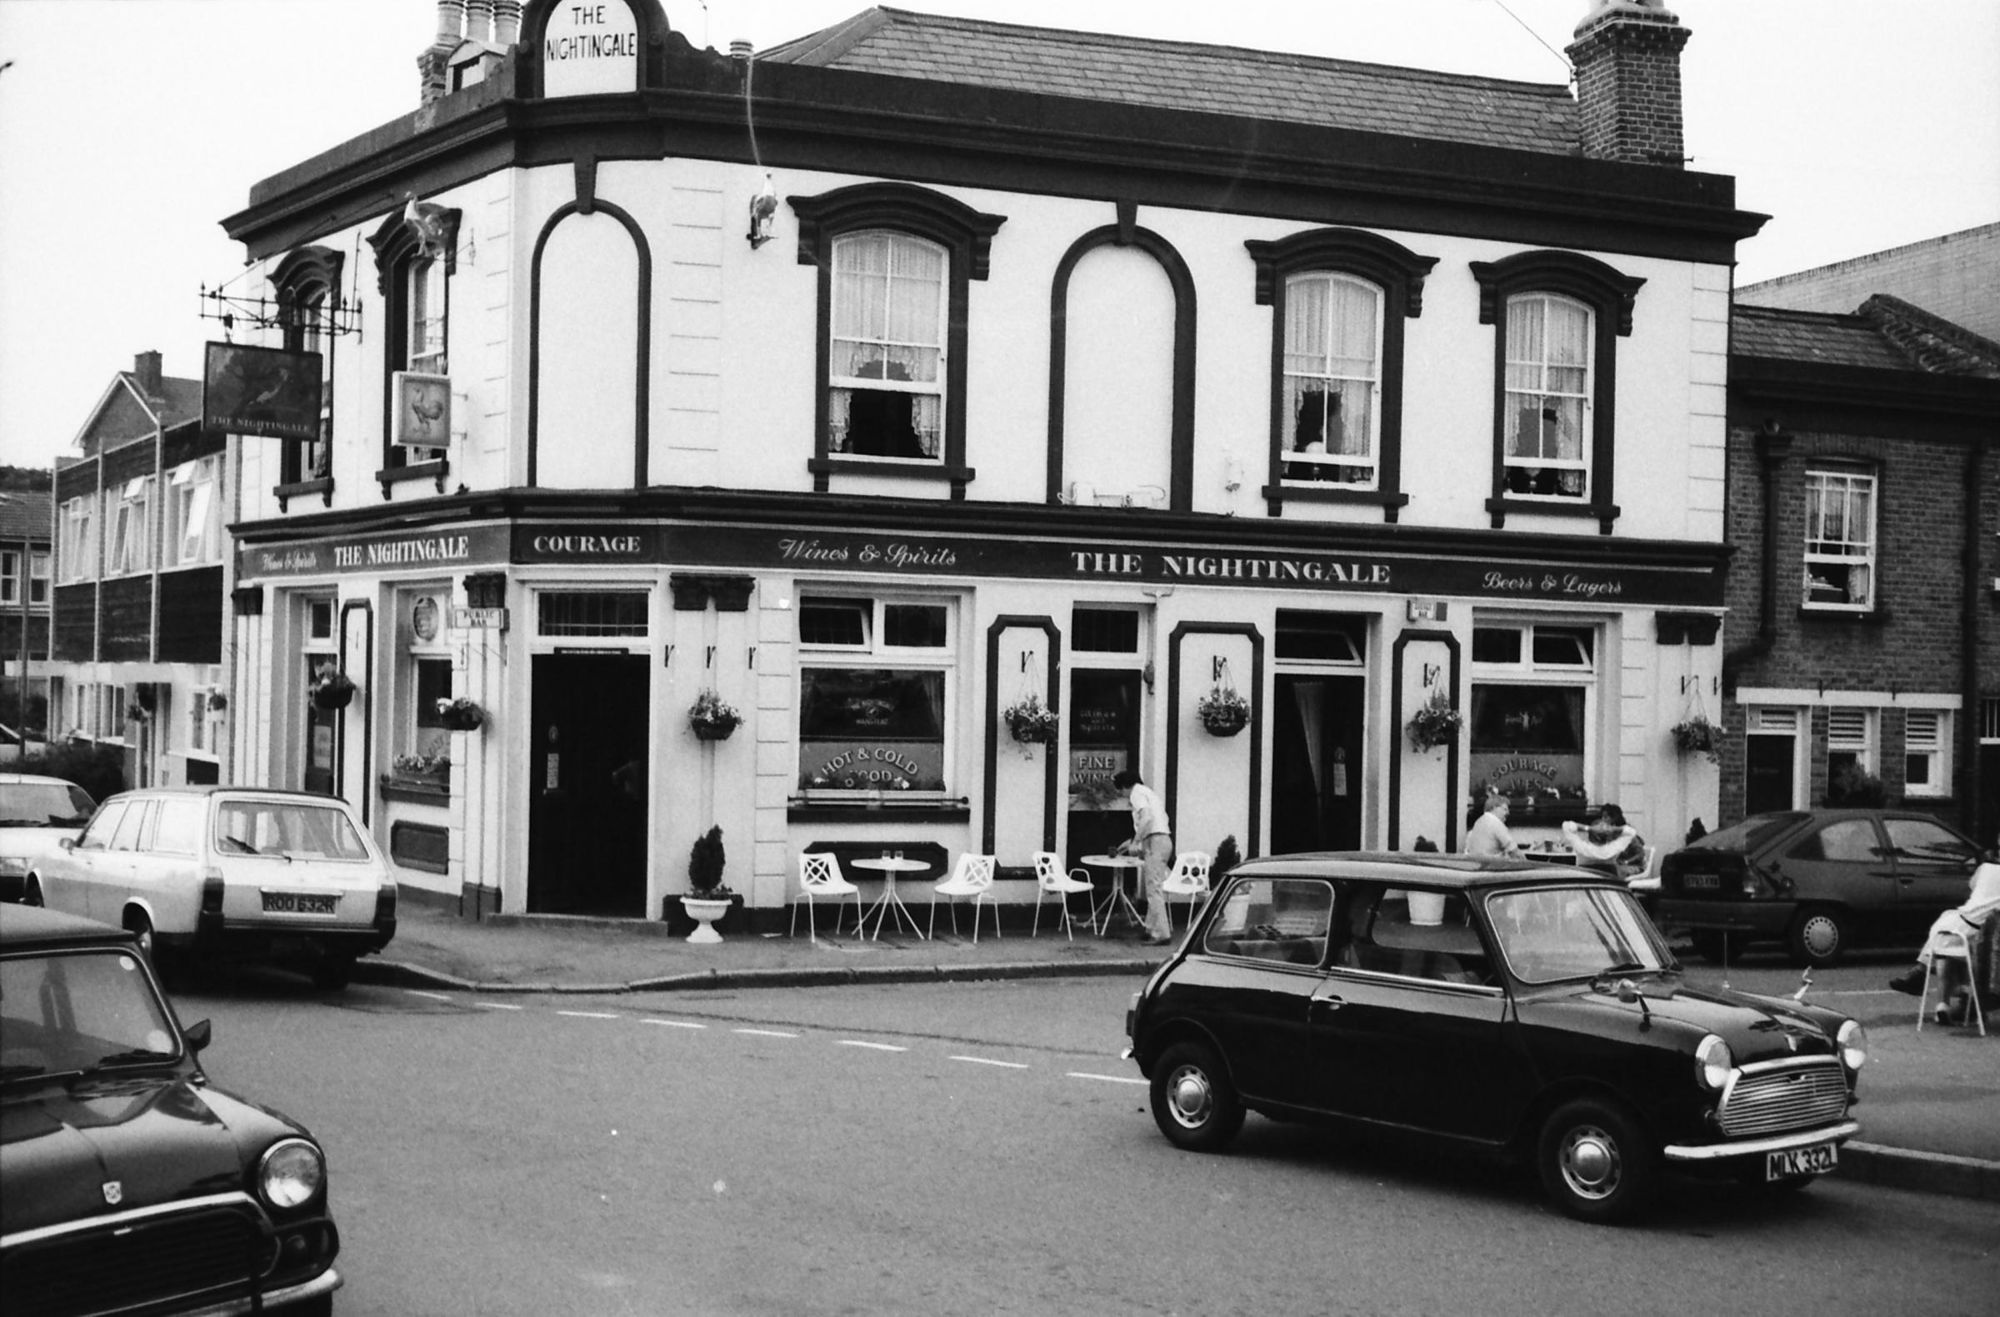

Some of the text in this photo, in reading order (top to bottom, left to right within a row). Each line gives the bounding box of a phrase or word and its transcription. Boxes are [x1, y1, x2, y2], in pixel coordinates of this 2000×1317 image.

[572, 6, 606, 25] THE
[546, 32, 636, 60] NIGHTINGALE
[211, 415, 311, 433] THE NIGHTINGALE
[334, 535, 469, 567] THE NIGHTINGALE
[533, 535, 641, 554] COURAGE
[777, 538, 957, 567] Wines & Spirits
[1071, 551, 1391, 584] THE NIGHTINGALE
[1481, 571, 1622, 598] Beers & Lagers
[821, 746, 919, 776] HOT & COLD
[1079, 756, 1115, 770] FINE
[1491, 757, 1558, 780] COURAGE
